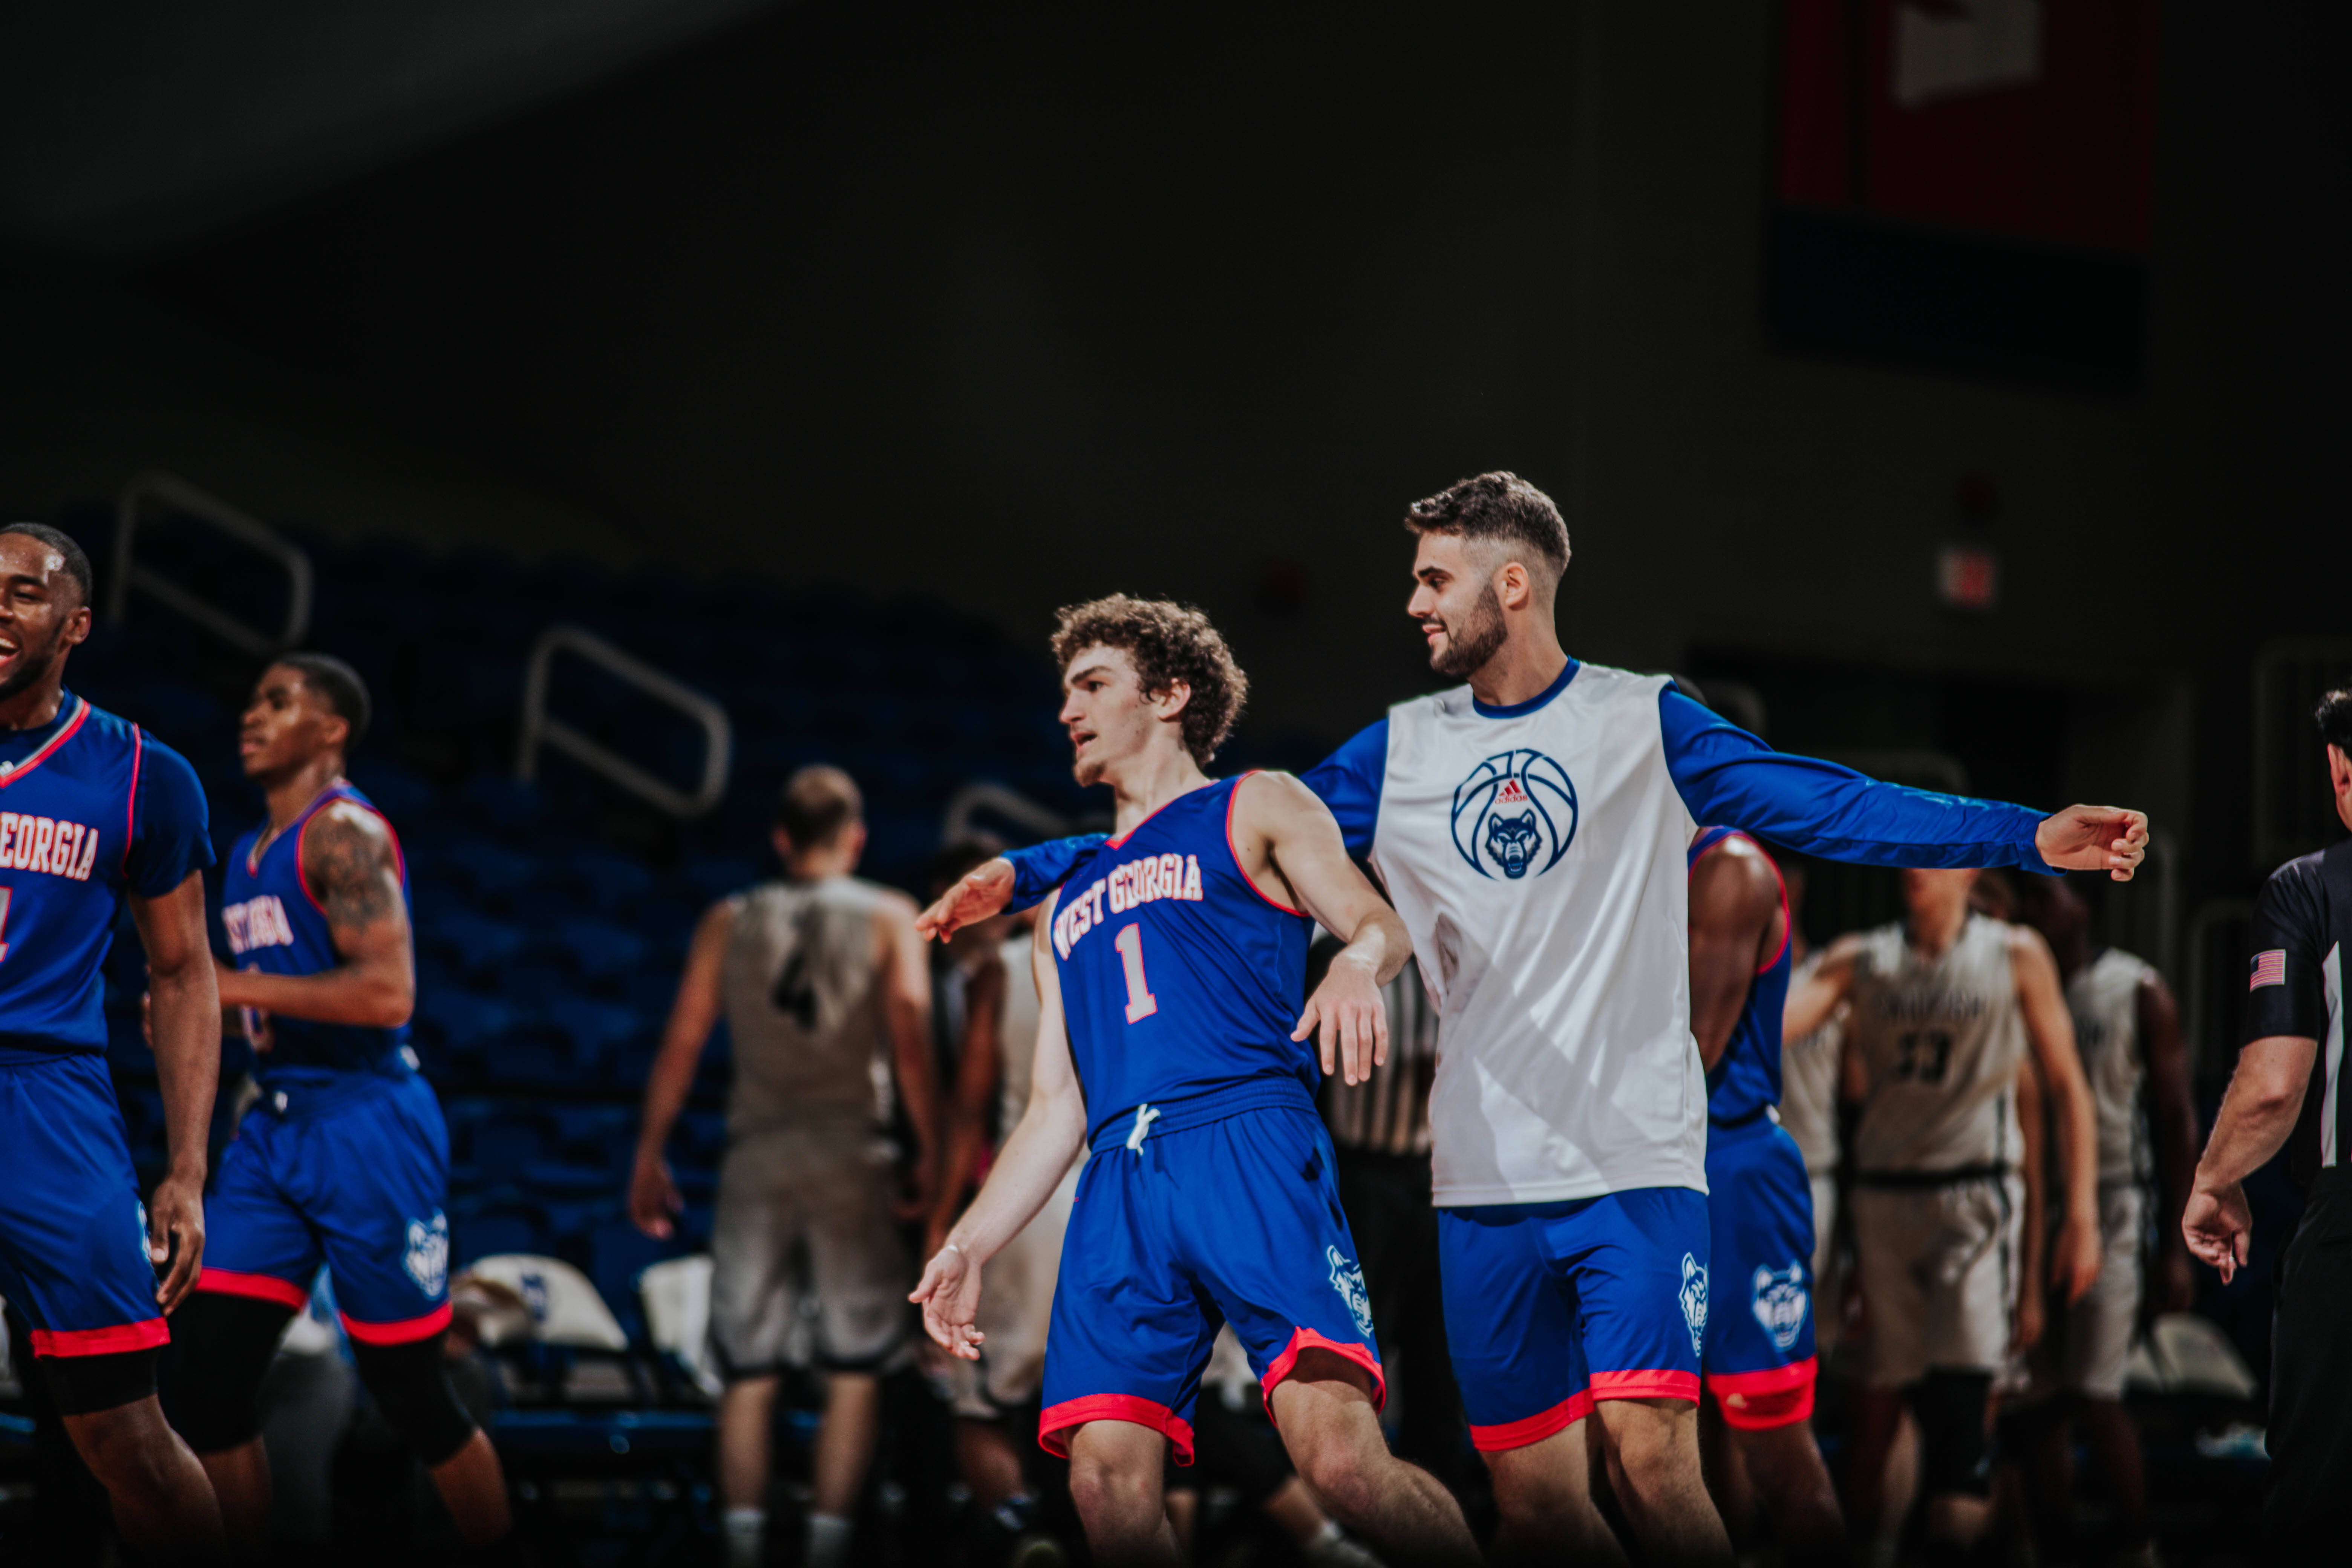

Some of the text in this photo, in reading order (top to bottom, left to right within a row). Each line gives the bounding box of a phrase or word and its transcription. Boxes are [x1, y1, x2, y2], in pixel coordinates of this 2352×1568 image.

[1495, 795, 1528, 804] adidas
[0, 812, 99, 881] EORGIA
[1053, 853, 1203, 961] WEST GEORGIA
[1115, 922, 1158, 1025] 1
